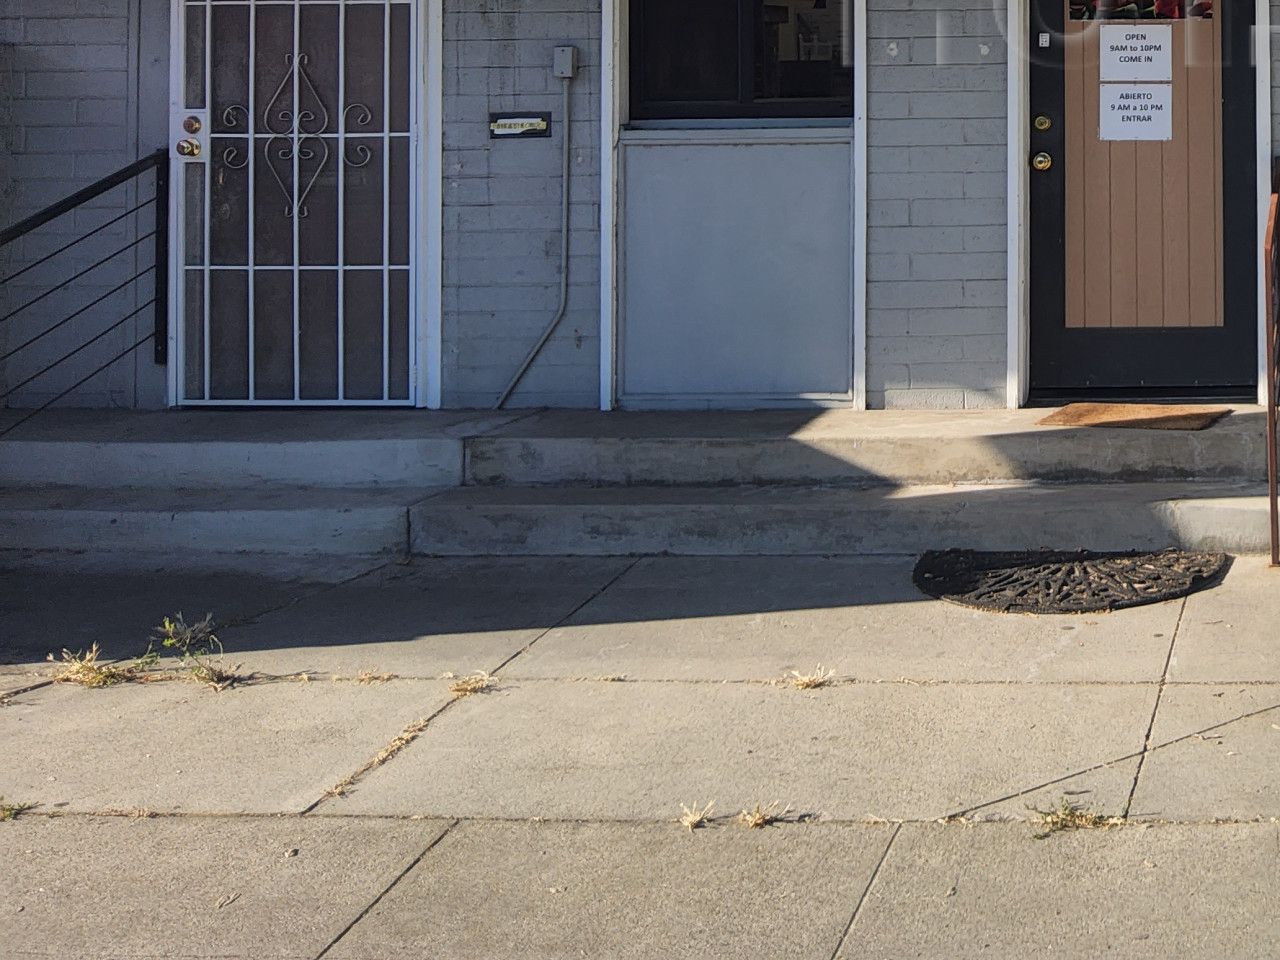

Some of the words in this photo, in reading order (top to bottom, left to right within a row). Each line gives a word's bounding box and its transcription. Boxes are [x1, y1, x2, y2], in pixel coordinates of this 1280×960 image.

[1125, 33, 1147, 41] OPEN
[1140, 44, 1162, 52] 10PM
[1119, 55, 1142, 63] COME
[1144, 55, 1153, 63] IN
